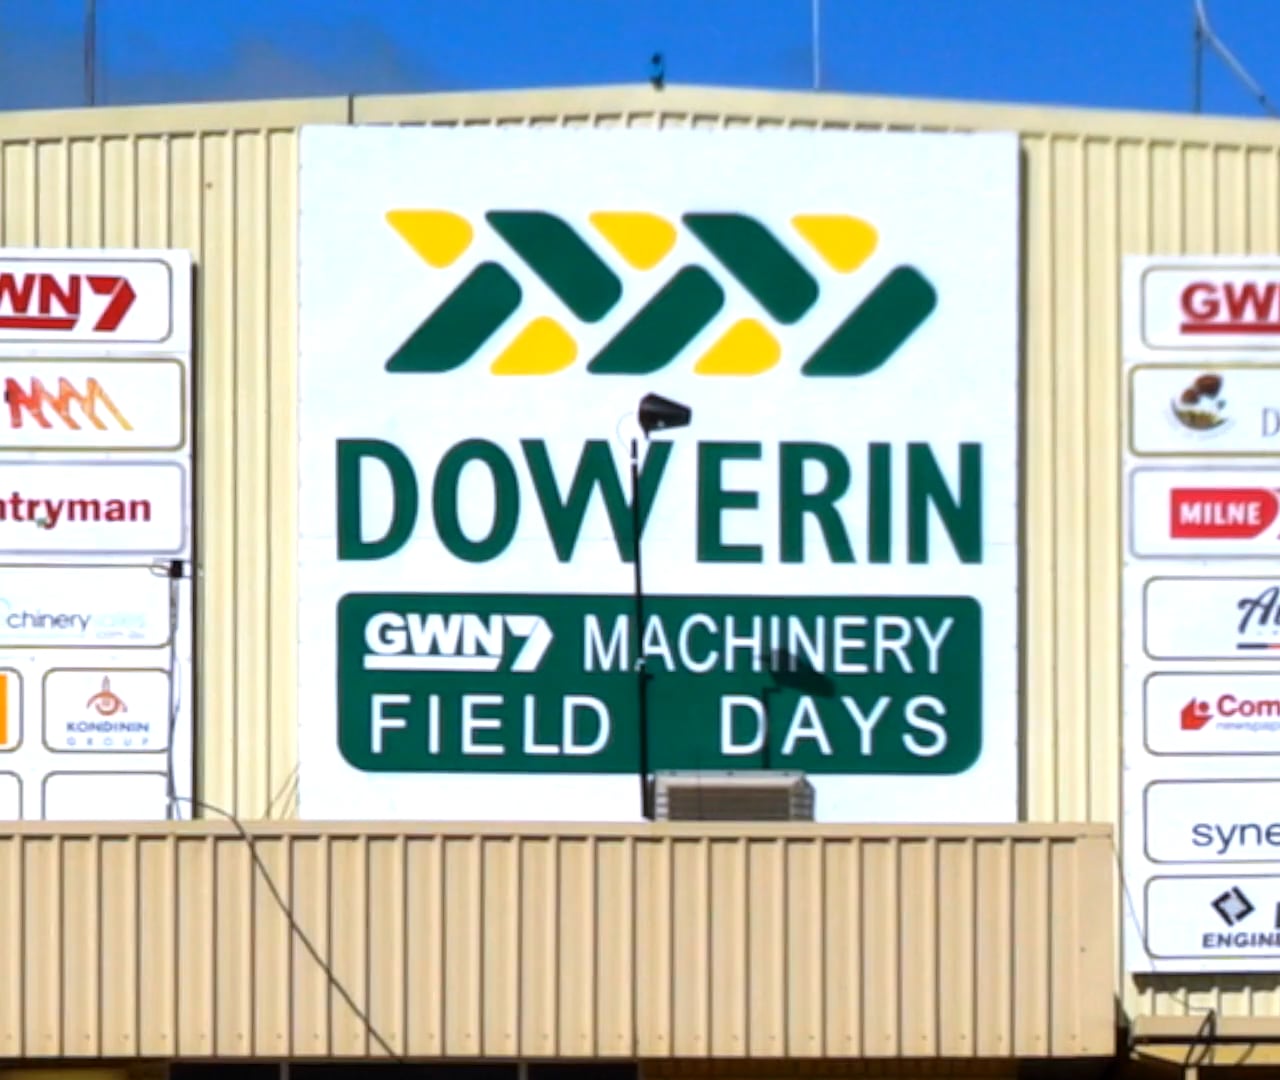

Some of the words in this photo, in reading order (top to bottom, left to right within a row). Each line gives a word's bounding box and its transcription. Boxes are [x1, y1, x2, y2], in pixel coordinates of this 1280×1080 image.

[0, 492, 151, 529] tryman
[336, 438, 983, 564] DOWERIN
[1180, 503, 1262, 525] MILNE
[363, 611, 554, 672] GWN7
[584, 614, 953, 674] MACHINERY
[370, 694, 611, 755] FIELD
[721, 695, 948, 757] DAYS
